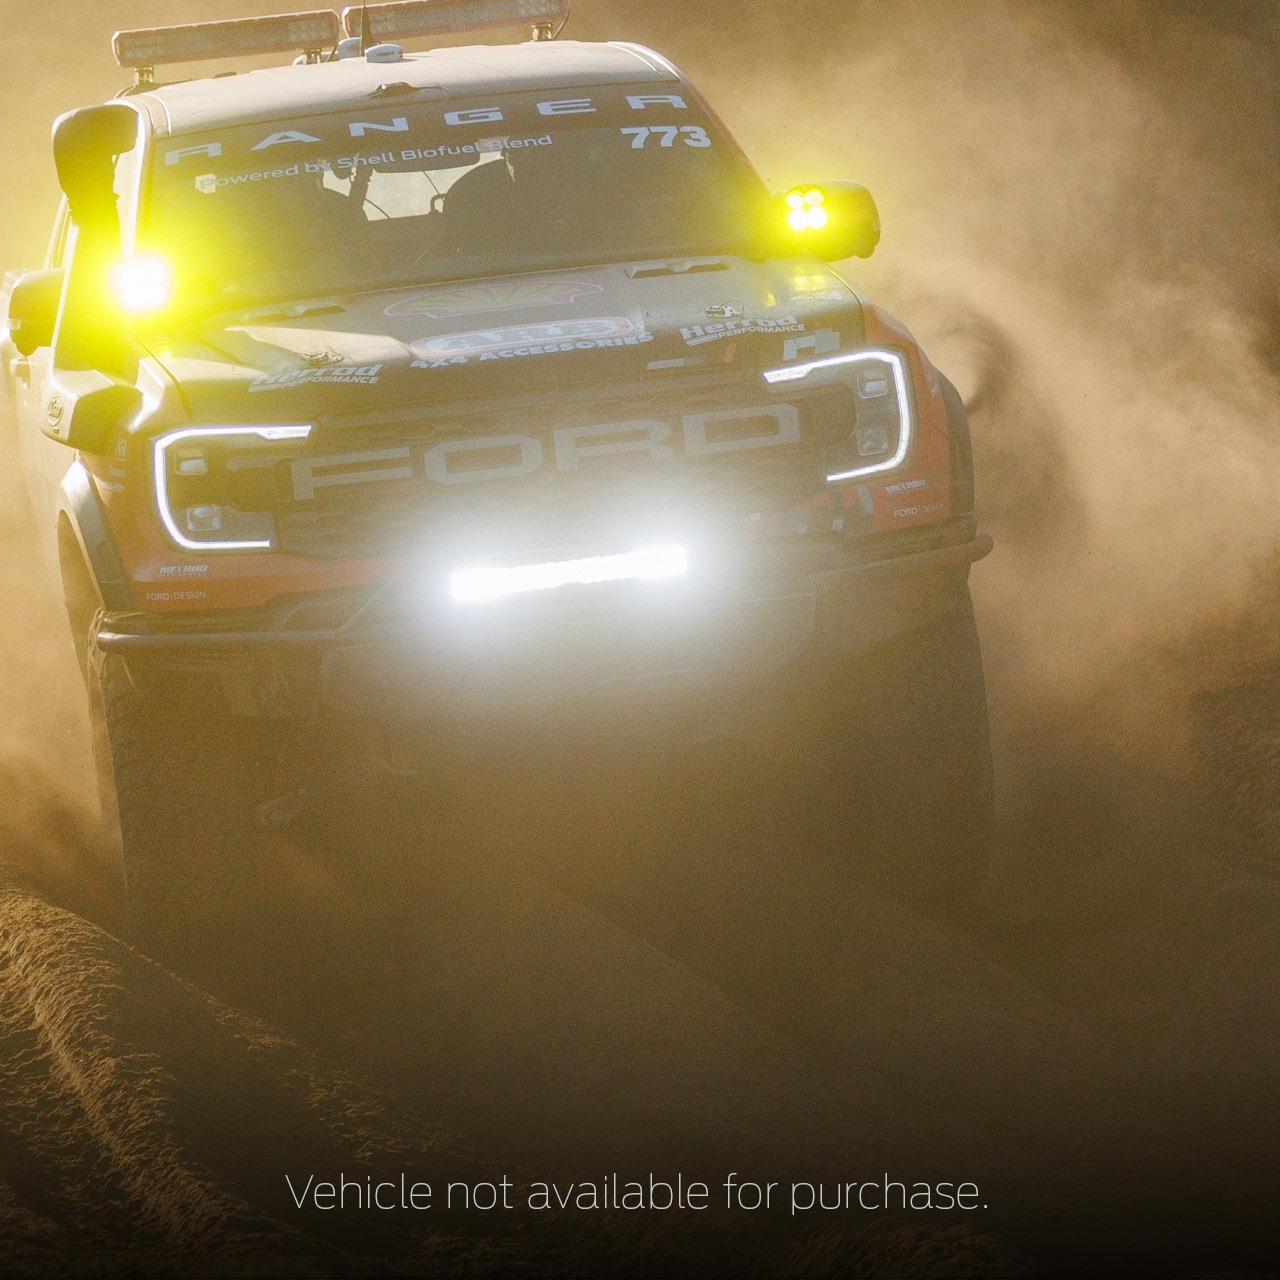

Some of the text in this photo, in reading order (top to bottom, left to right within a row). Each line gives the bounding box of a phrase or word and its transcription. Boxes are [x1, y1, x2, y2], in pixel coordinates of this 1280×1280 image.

[165, 94, 688, 166] RANGER
[620, 125, 712, 150] 773
[199, 134, 553, 190] Powered by Shell Biofuel Blend
[424, 319, 619, 353] ARB
[679, 315, 798, 340] Herrod
[718, 323, 806, 339] PERFORMANCE
[479, 331, 655, 361] ACCESSORIES
[280, 375, 380, 389] PERFORMANCE
[291, 404, 802, 501] FORD
[893, 506, 918, 518] FORD
[146, 590, 206, 601] FORD DESIGN
